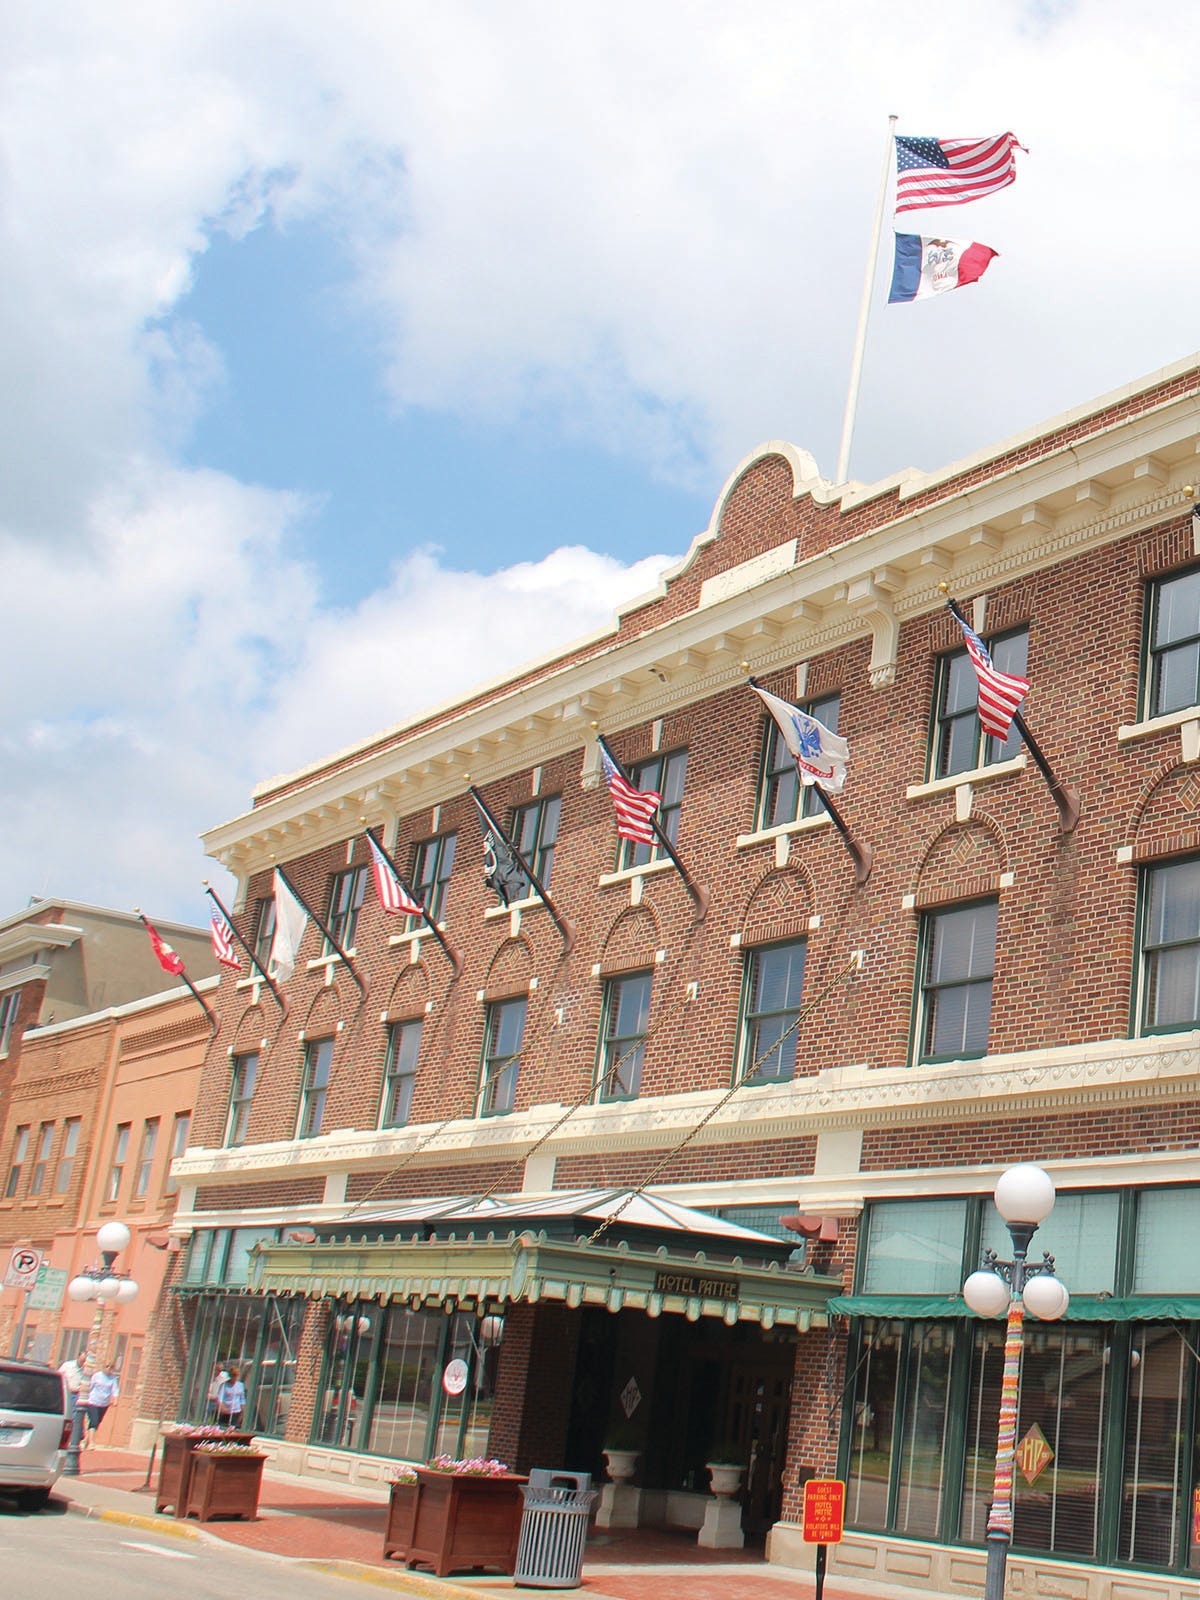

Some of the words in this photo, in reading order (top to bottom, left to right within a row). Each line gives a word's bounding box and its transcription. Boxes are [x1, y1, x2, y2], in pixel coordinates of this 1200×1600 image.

[657, 1274, 696, 1293] HOTEL
[697, 1280, 737, 1298] PATTEE
[1022, 1438, 1045, 1471] HP
[807, 1493, 827, 1501] PARKING
[815, 1501, 832, 1510] HOTEL
